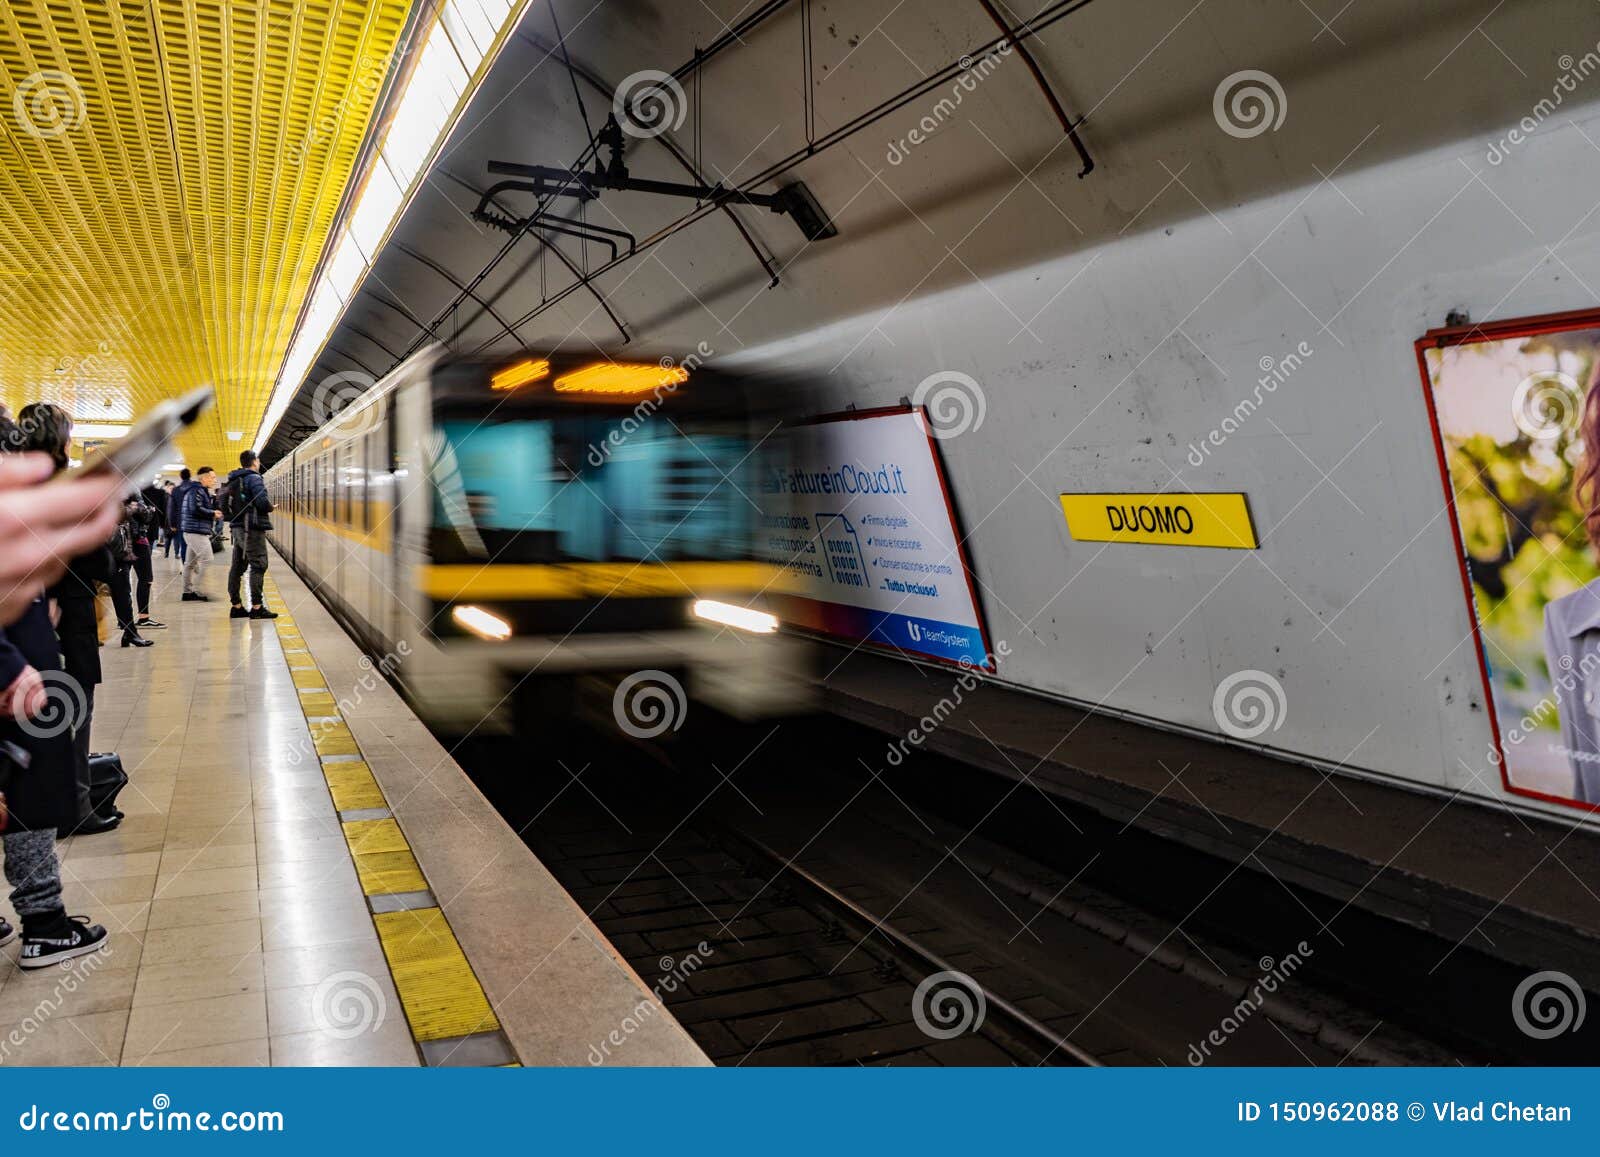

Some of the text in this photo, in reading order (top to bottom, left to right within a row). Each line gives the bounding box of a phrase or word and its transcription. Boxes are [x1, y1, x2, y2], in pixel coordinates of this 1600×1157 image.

[780, 463, 907, 494] FattureinCloud.it
[1106, 505, 1194, 534] DUOMO
[921, 626, 969, 647] TeamSystem
